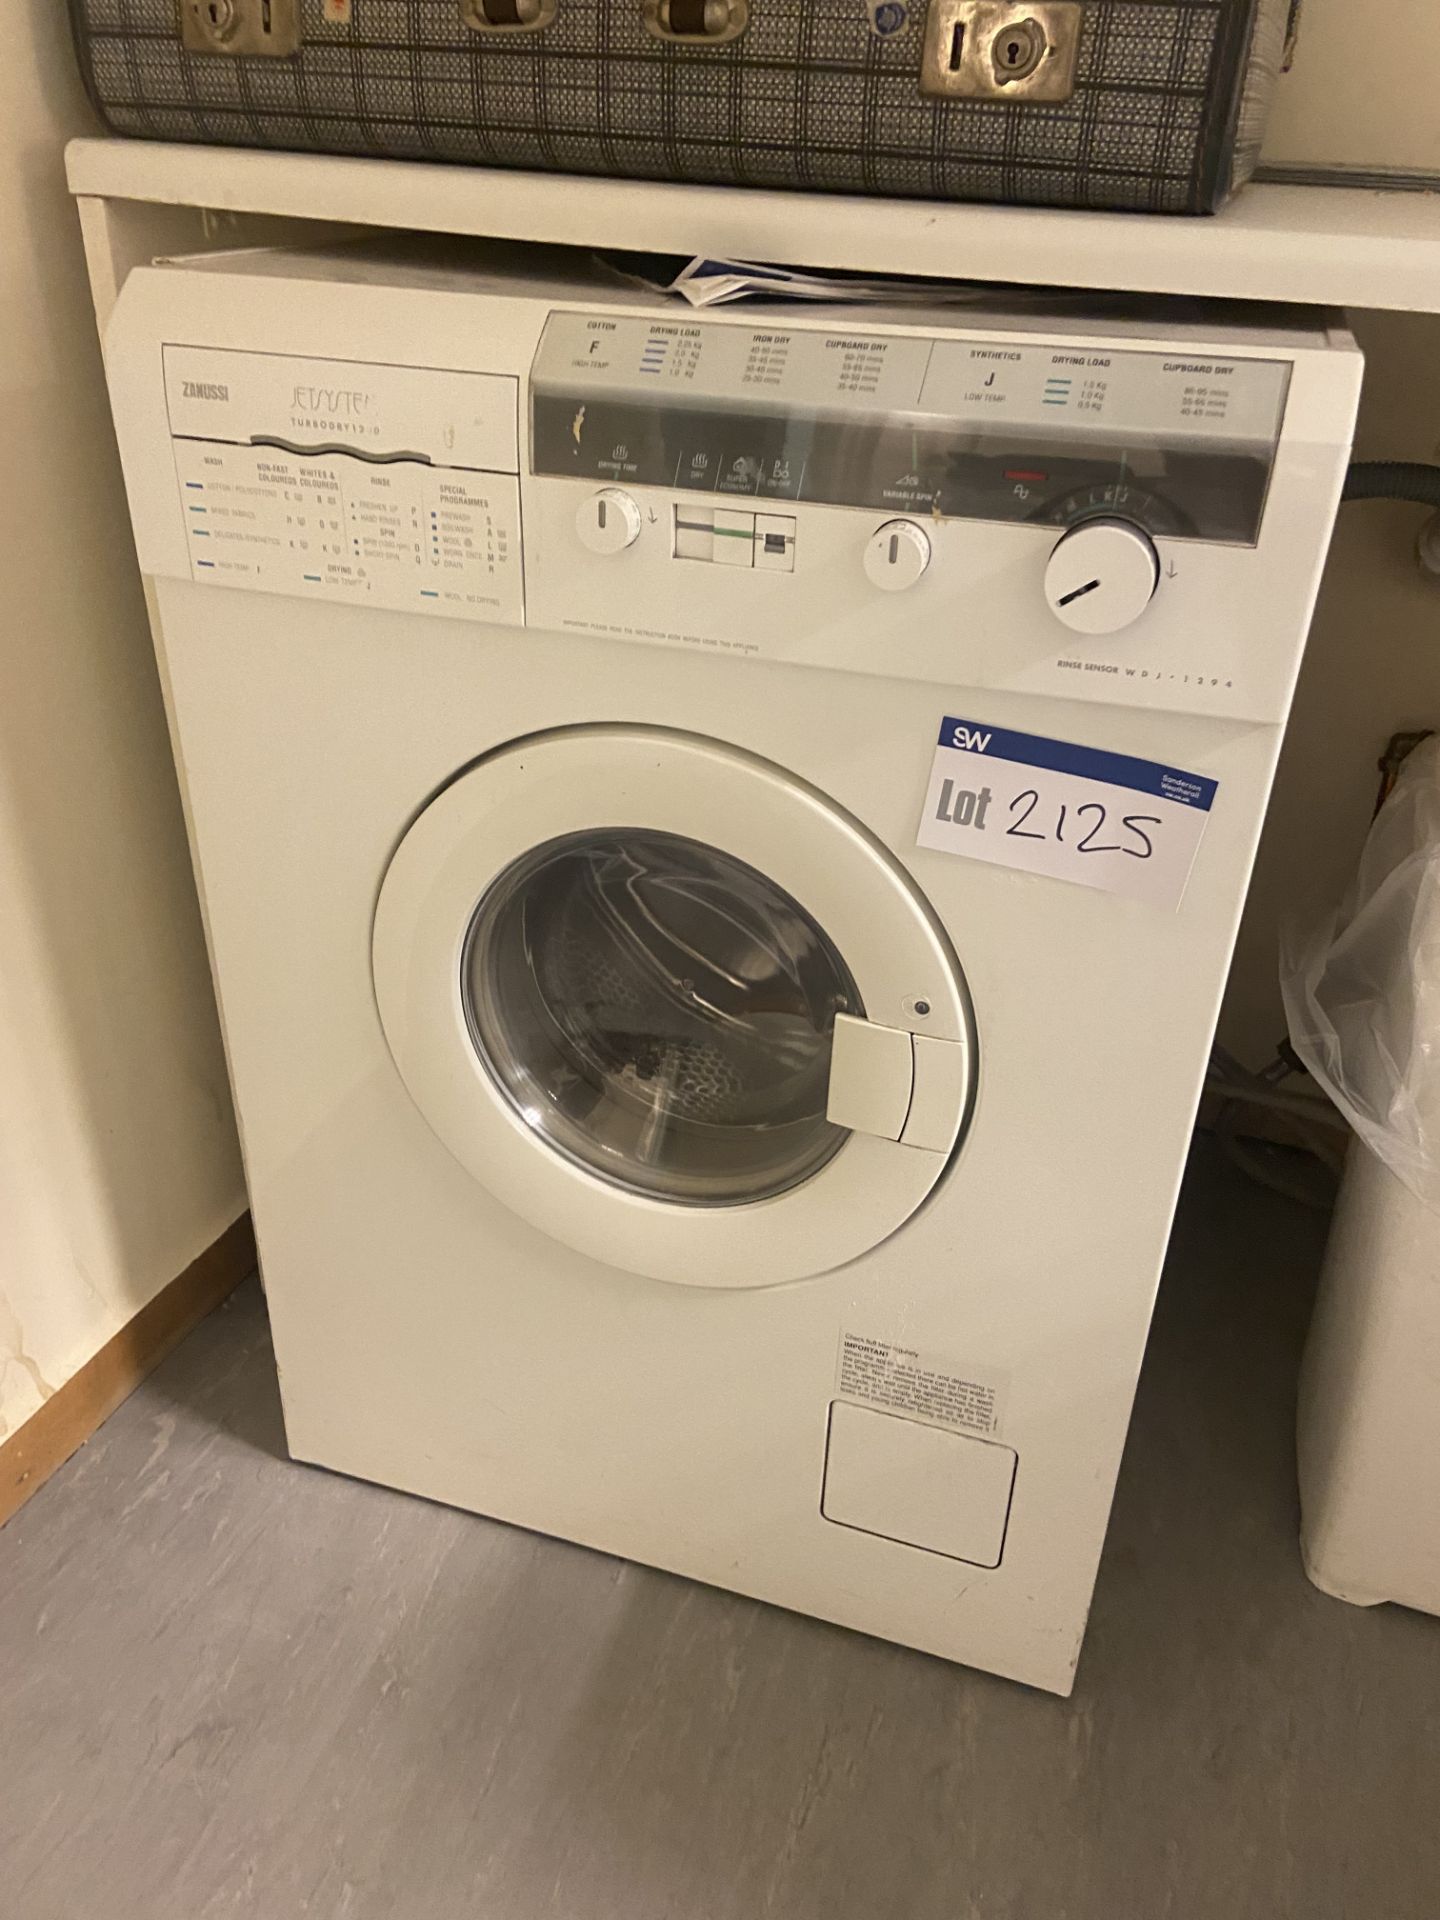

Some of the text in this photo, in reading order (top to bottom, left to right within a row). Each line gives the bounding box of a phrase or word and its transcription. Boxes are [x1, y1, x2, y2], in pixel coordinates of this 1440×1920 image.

[587, 320, 616, 331] COTTON
[650, 326, 701, 337] DRYING LOAD
[753, 335, 790, 344] IRON DRY
[826, 340, 888, 352] CUPBOARD DRY
[590, 340, 599, 354] F
[970, 350, 1022, 361] SYNTHETICS
[1052, 355, 1111, 368] DRYING LOAD
[1162, 362, 1234, 375] CUPBOARD DRY
[984, 372, 996, 386] J
[182, 381, 229, 402] ZANUSSI
[964, 392, 983, 402] LOW
[299, 467, 326, 478] WHITES
[370, 476, 390, 487] RINSE
[439, 484, 465, 495] SPECIAL
[439, 493, 488, 508] PROGRAMMES
[1057, 660, 1082, 670] RINSE
[1084, 663, 1119, 674] SENSOR
[952, 726, 992, 752] SW
[1162, 774, 1202, 791] Sanderson
[936, 778, 992, 830] Lot
[843, 1340, 888, 1358] IMPORTANT
